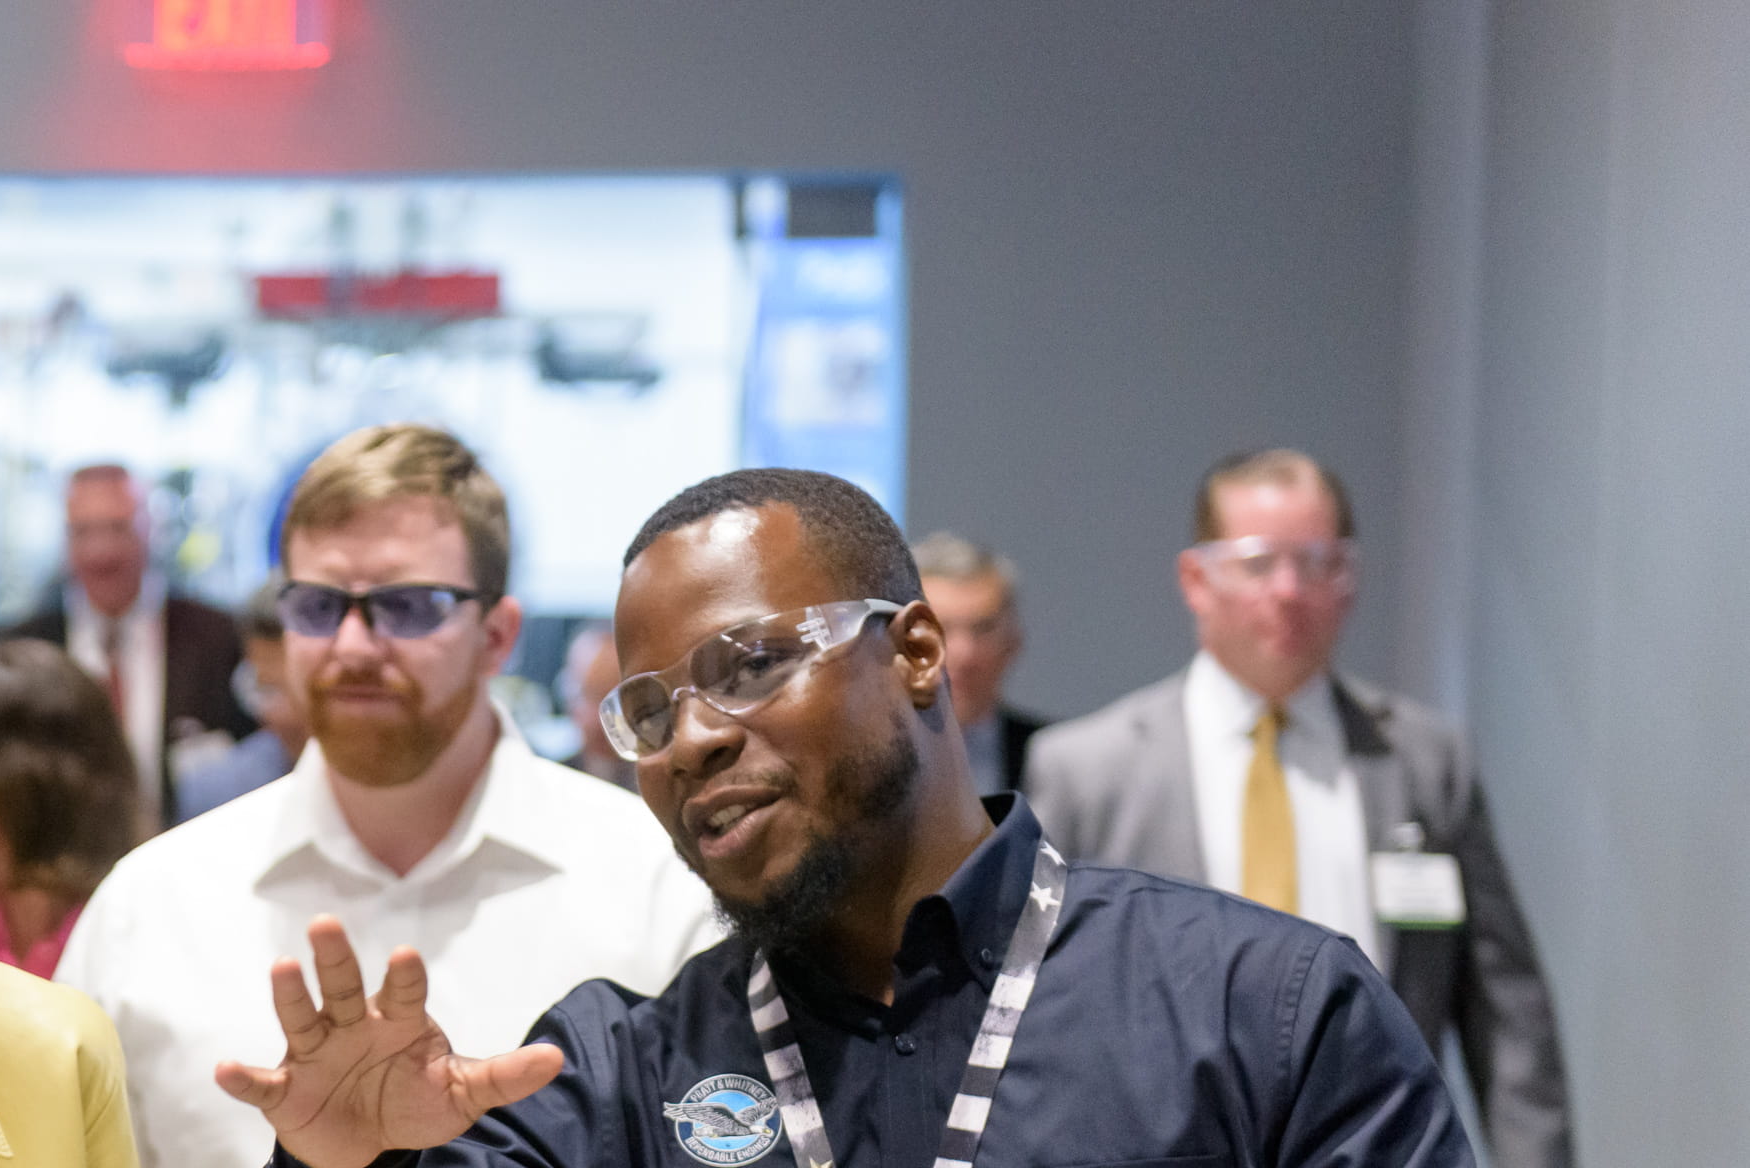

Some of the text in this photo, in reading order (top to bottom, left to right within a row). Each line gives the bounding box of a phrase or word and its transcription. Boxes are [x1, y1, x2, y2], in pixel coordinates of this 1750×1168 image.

[690, 1078, 767, 1102] PRATT & WHITNEY
[685, 1135, 770, 1162] DEPENDABLE ENGINES
